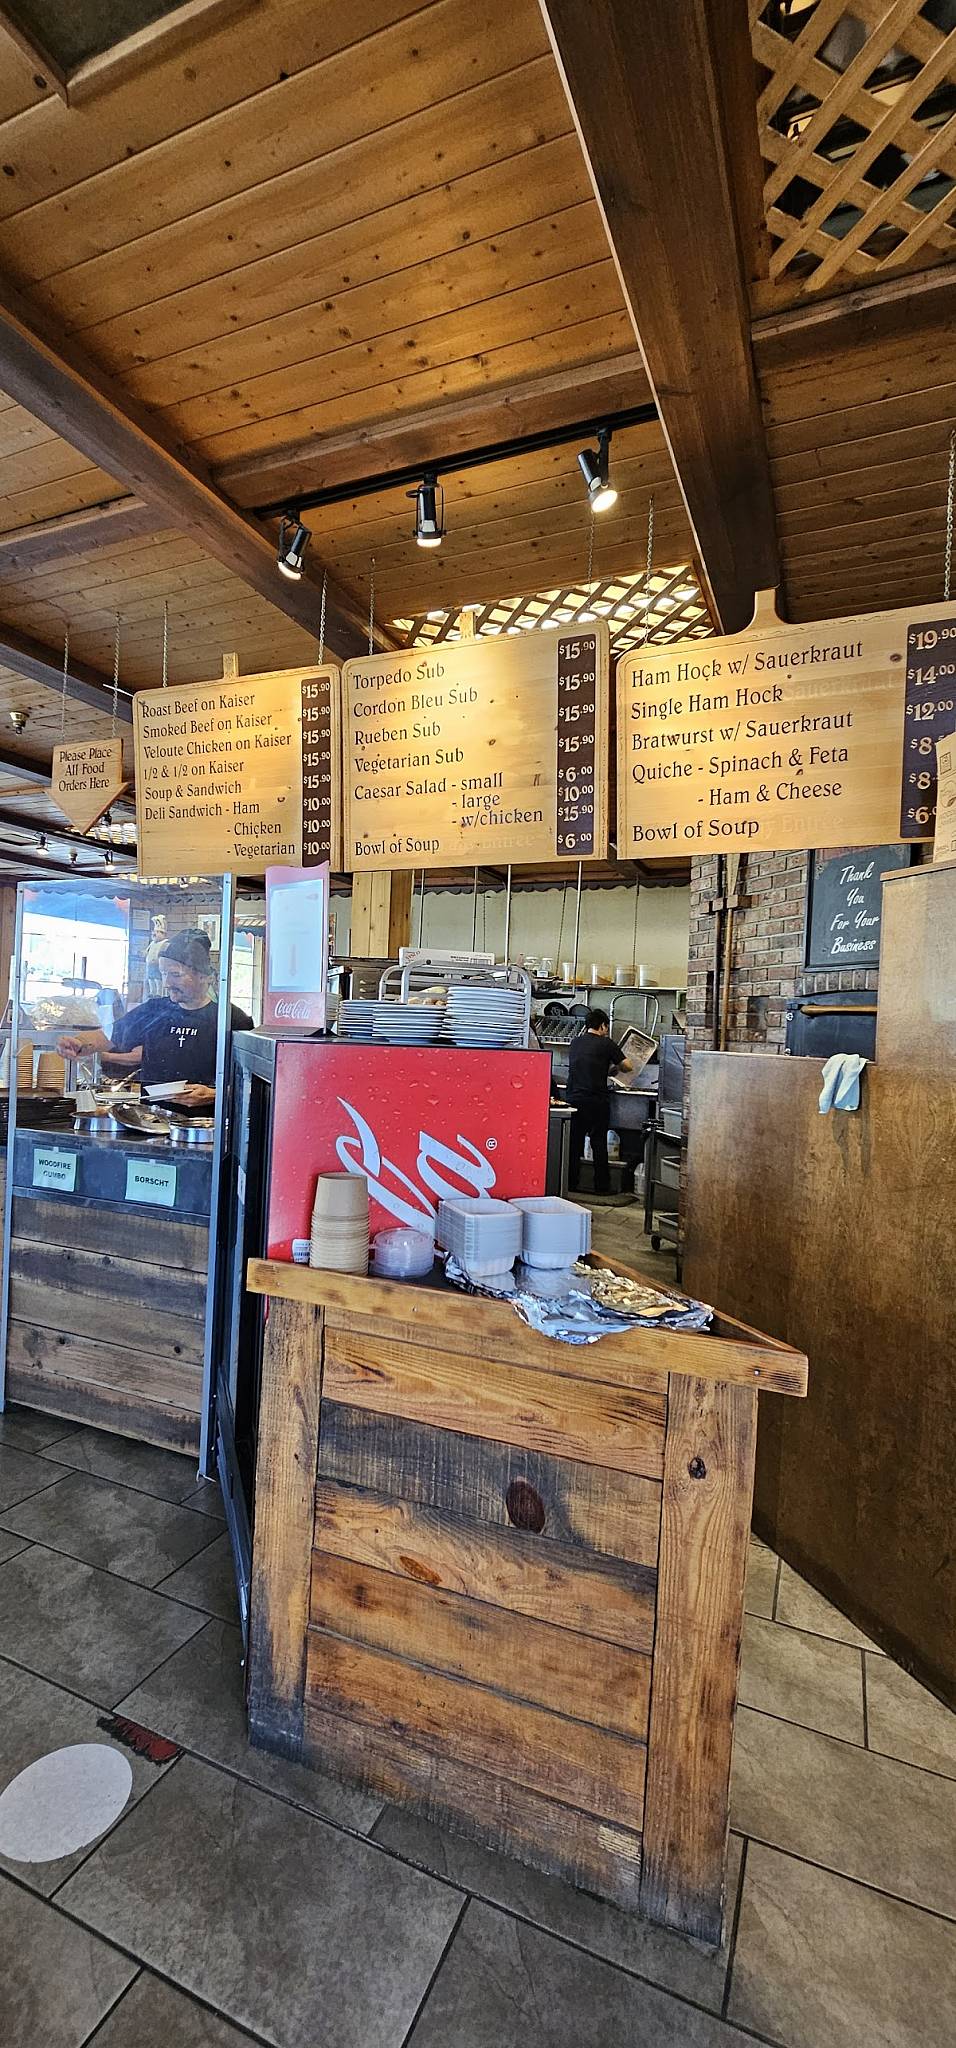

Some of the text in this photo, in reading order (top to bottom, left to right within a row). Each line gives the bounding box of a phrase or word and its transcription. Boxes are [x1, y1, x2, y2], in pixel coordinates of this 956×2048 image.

[908, 627, 956, 650] $19.90
[559, 640, 595, 659] $15.90
[631, 641, 863, 688] Ham Hock w/ Sauerkraut
[353, 664, 445, 690] Torpedo Sub
[559, 673, 594, 691] $15.90
[907, 664, 955, 685] $14.00
[302, 683, 329, 698] $15.90
[142, 694, 255, 718] Roast Beef on Kaiser
[353, 687, 478, 717] Cordon Bleu Sub
[631, 698, 682, 720] Single
[689, 693, 728, 712] Ham
[736, 684, 783, 707] Hock
[906, 701, 953, 721] $12.00
[303, 706, 330, 721] $15.90
[559, 704, 594, 721] $15.90
[143, 713, 272, 738] Smoked Beef on Kaiser
[355, 723, 440, 745] Rueben Sub
[632, 712, 853, 751] Bratwurst w/ Sauerkraut
[303, 729, 330, 744] $15.90
[558, 735, 594, 753] $15.90
[60, 748, 112, 762] Please Place
[144, 734, 291, 759] Veloute Chicken on Kaiser
[303, 752, 330, 766] $15.90
[355, 748, 464, 774] Vegetarian Sub
[632, 762, 692, 784] Quiche
[709, 751, 782, 775] Spinach
[788, 749, 803, 766] &
[809, 746, 849, 764] Feta
[65, 762, 104, 776] All Food
[144, 761, 244, 780] 1/2 & 1/2 on Kaiser
[558, 766, 592, 782] $6.00
[59, 777, 109, 791] Orders Here
[304, 775, 330, 788] $15.90
[355, 784, 401, 800] Caesar
[406, 779, 446, 795] Salad
[461, 772, 503, 790] small
[145, 781, 242, 801] Soup & Sandwich
[558, 785, 593, 802] $10.00
[709, 788, 750, 806] Ham
[756, 784, 770, 801] &
[776, 781, 842, 799] Cheese
[304, 798, 330, 811] $10.00
[462, 793, 500, 809] large
[145, 807, 165, 819] Deli
[169, 804, 222, 818] Sandwich
[233, 802, 259, 814] Ham
[462, 809, 543, 827] w/chicken
[558, 804, 593, 821] $15.90
[907, 806, 937, 823] $6.0
[234, 822, 281, 835] Chicken
[304, 820, 330, 833] $10.00
[633, 822, 677, 842] Bowl
[684, 821, 703, 839] of
[709, 819, 759, 837] Soup
[304, 842, 330, 854] $10.00
[355, 839, 439, 855] Bowl of Soup
[558, 833, 591, 848] $6.00
[235, 843, 295, 858] Vegetarian
[840, 862, 874, 884] Thank
[847, 888, 864, 906] You
[830, 910, 879, 931] For Your
[831, 937, 876, 954] Business
[170, 1027, 197, 1035] FAITH
[135, 1175, 168, 1188] BORSCHT
